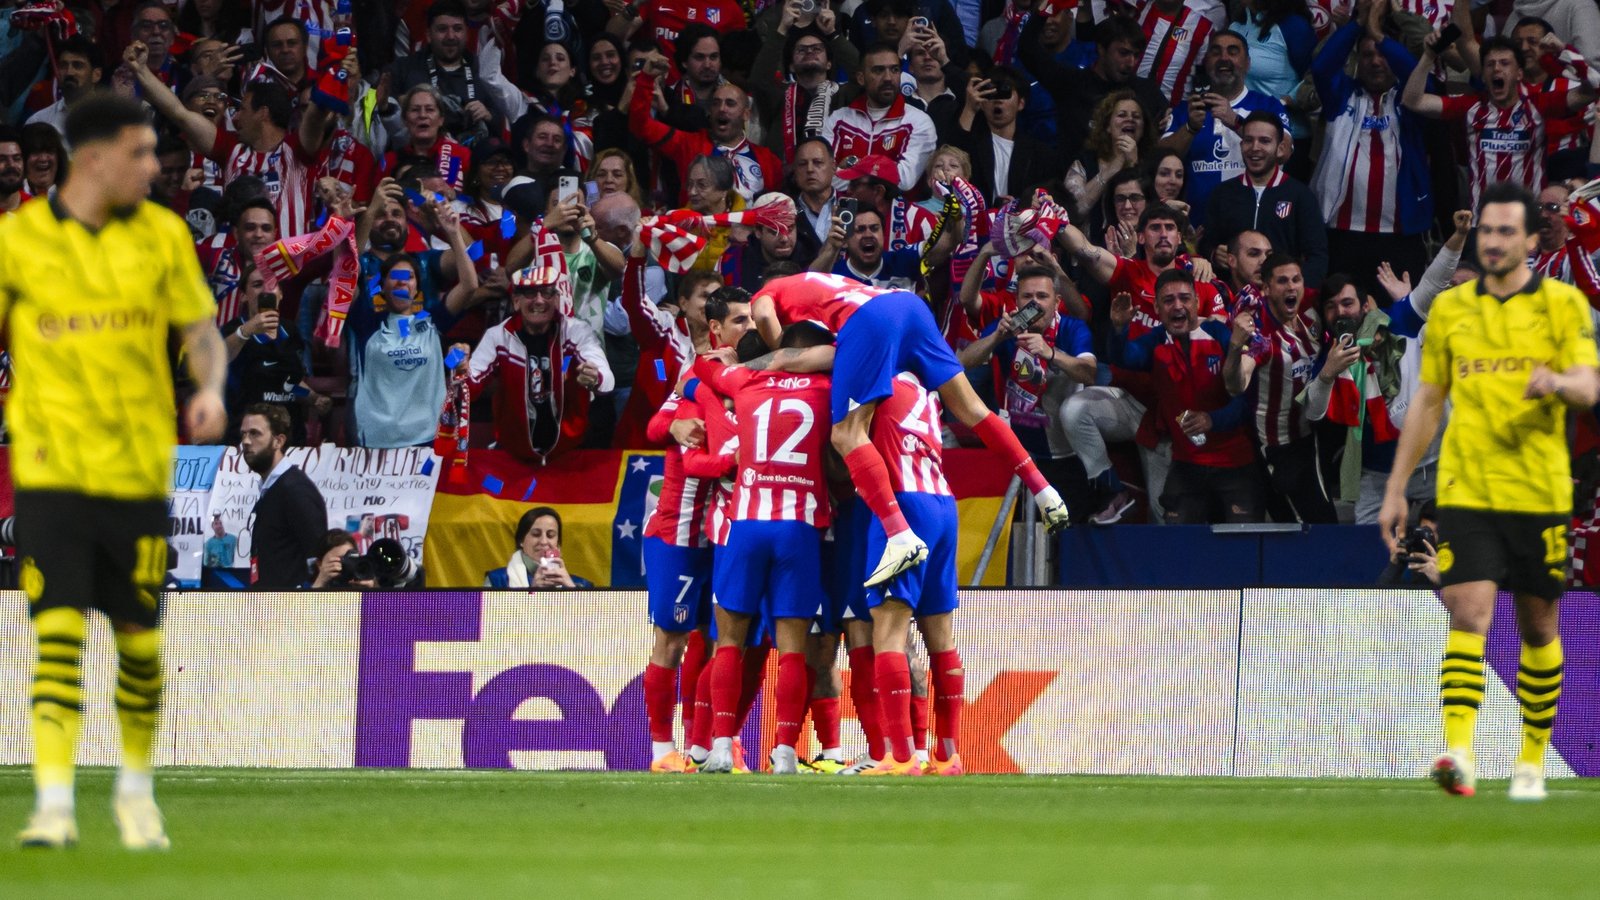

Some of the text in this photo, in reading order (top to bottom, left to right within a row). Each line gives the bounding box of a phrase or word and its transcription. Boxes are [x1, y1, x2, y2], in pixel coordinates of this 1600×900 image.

[1492, 130, 1519, 140] Trade
[1481, 141, 1529, 151] Plus500
[1191, 160, 1240, 173] WhaleFin
[387, 346, 422, 358] capital
[394, 357, 428, 367] energy
[752, 397, 815, 465] 12
[757, 473, 773, 482] Save
[788, 475, 815, 486] Children
[1541, 524, 1568, 564] 15
[674, 574, 695, 604] 7
